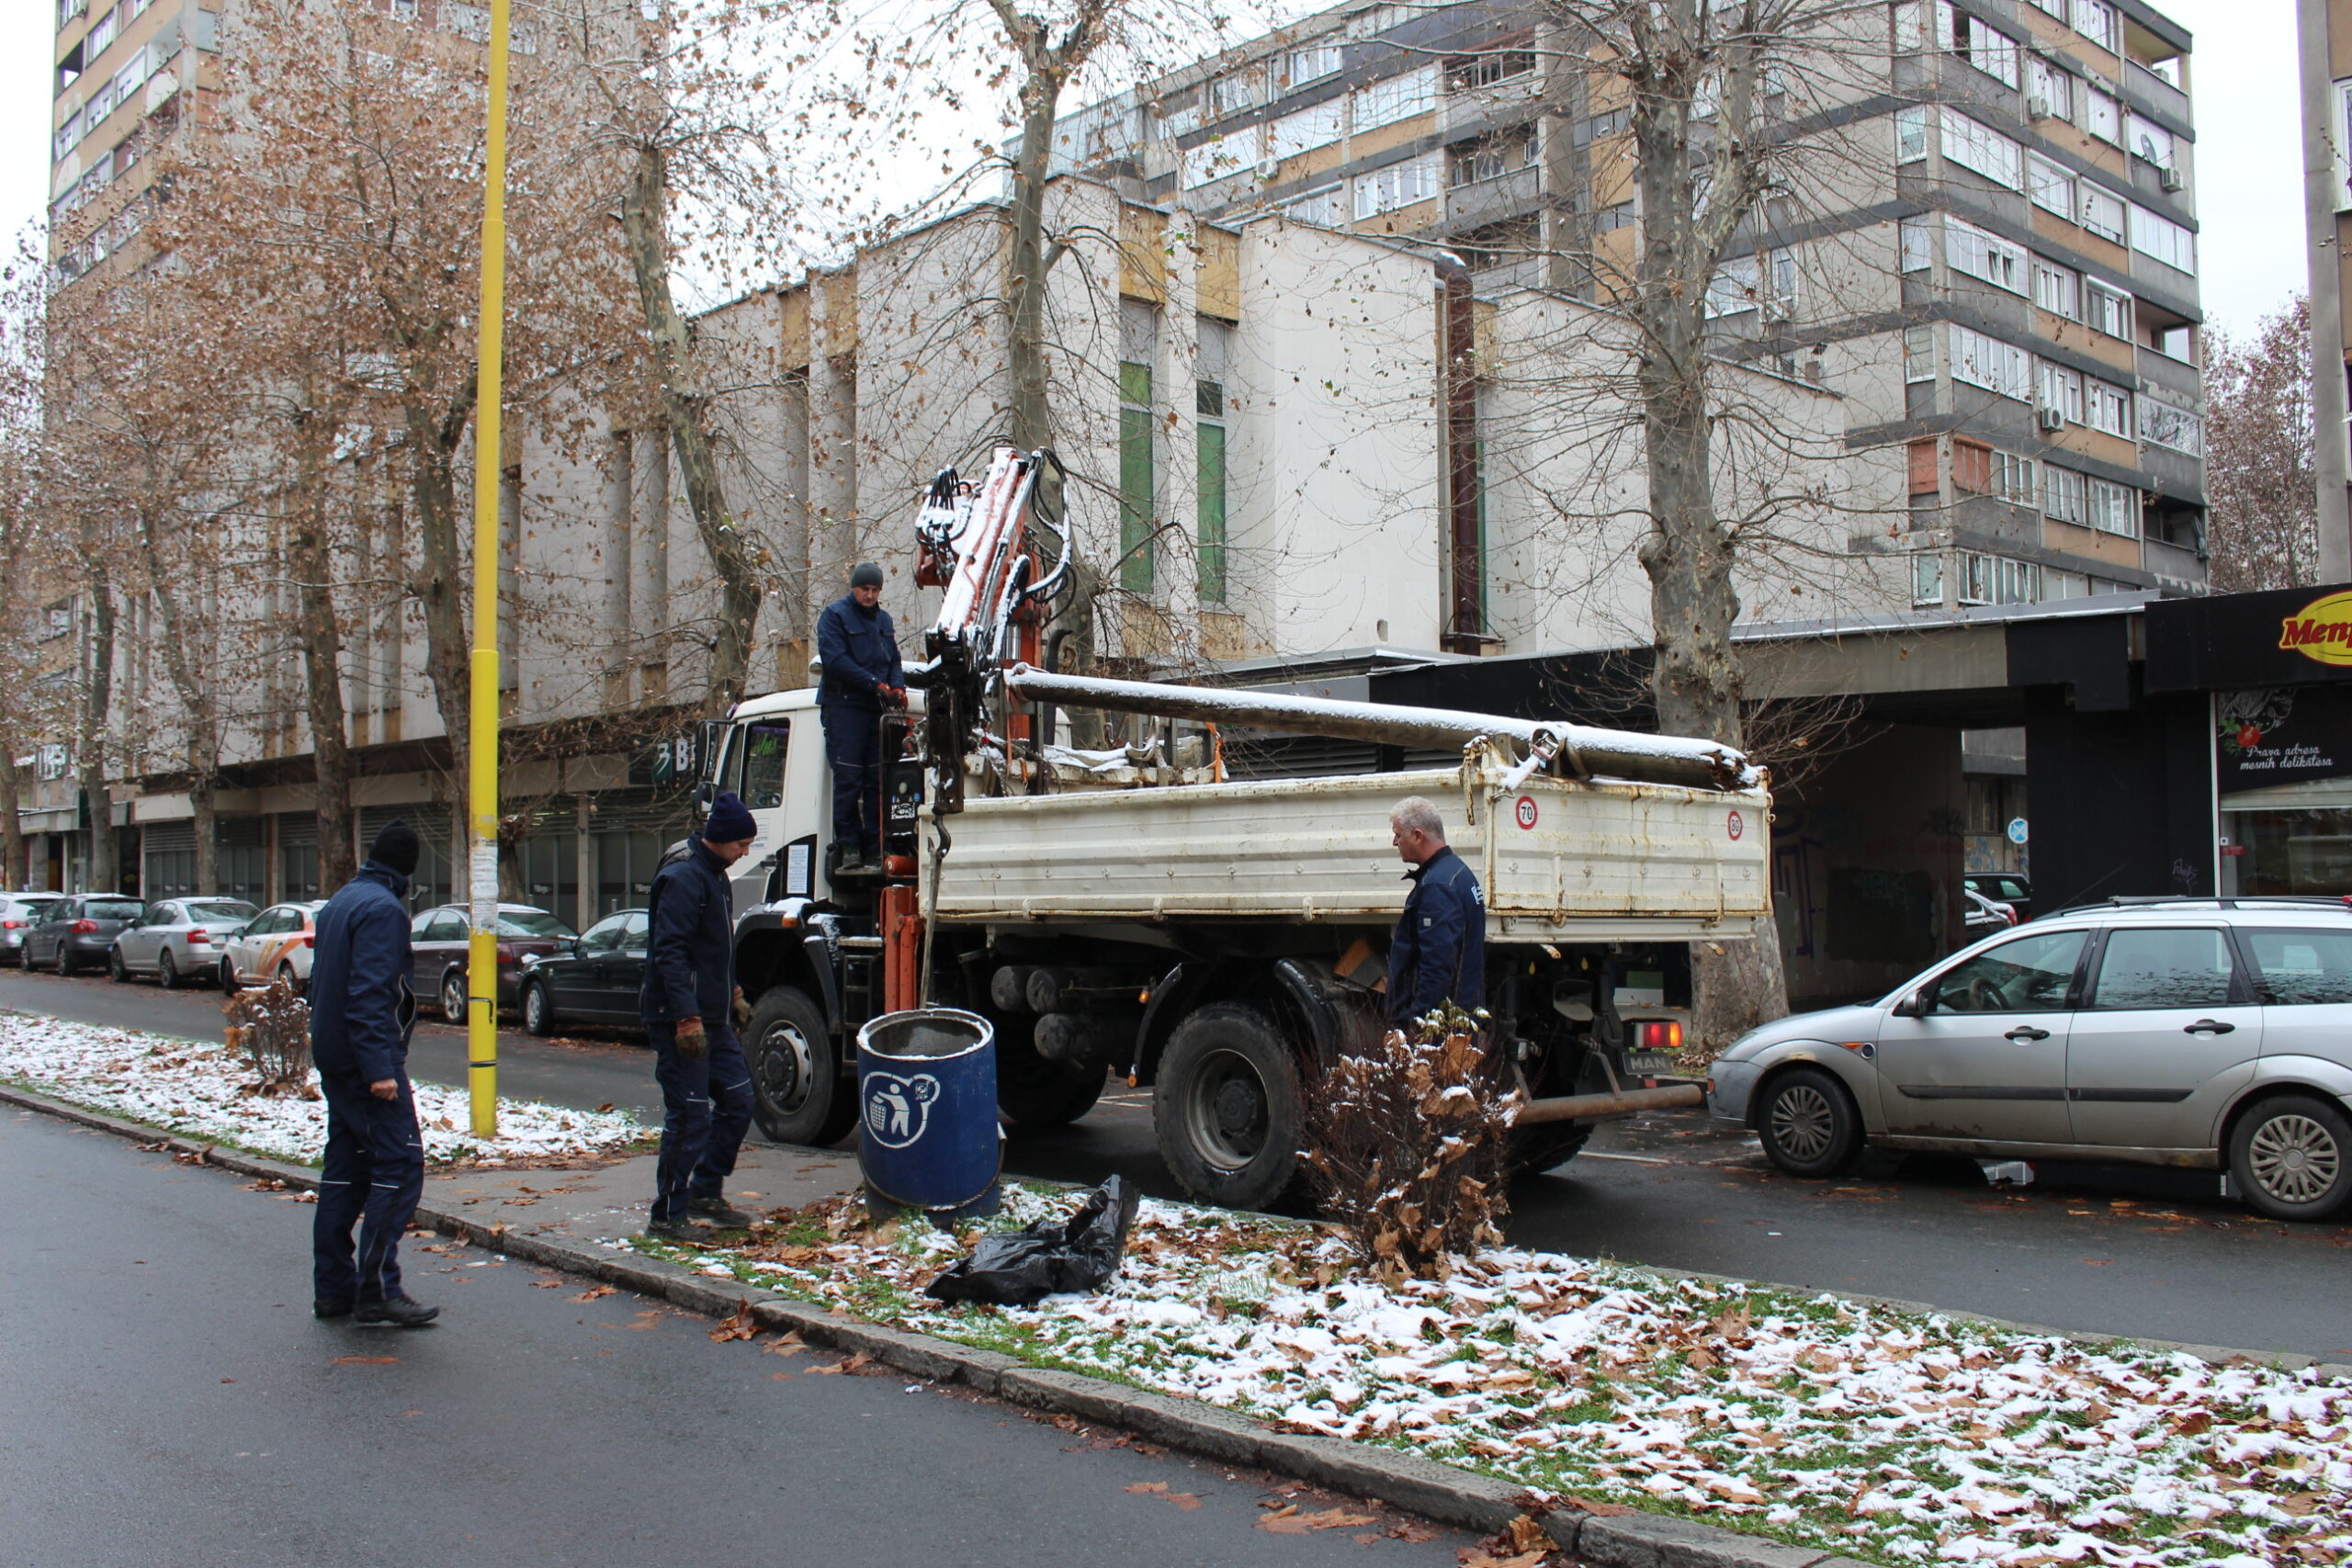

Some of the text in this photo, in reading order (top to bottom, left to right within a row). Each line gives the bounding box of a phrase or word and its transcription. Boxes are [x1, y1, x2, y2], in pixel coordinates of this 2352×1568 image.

[2282, 619, 2352, 649] Men
[2246, 742, 2321, 757] Prava adresa
[2240, 755, 2334, 770] mesnih delikatesa
[1521, 806, 1533, 820] 70
[1630, 1056, 1668, 1070] MAN
